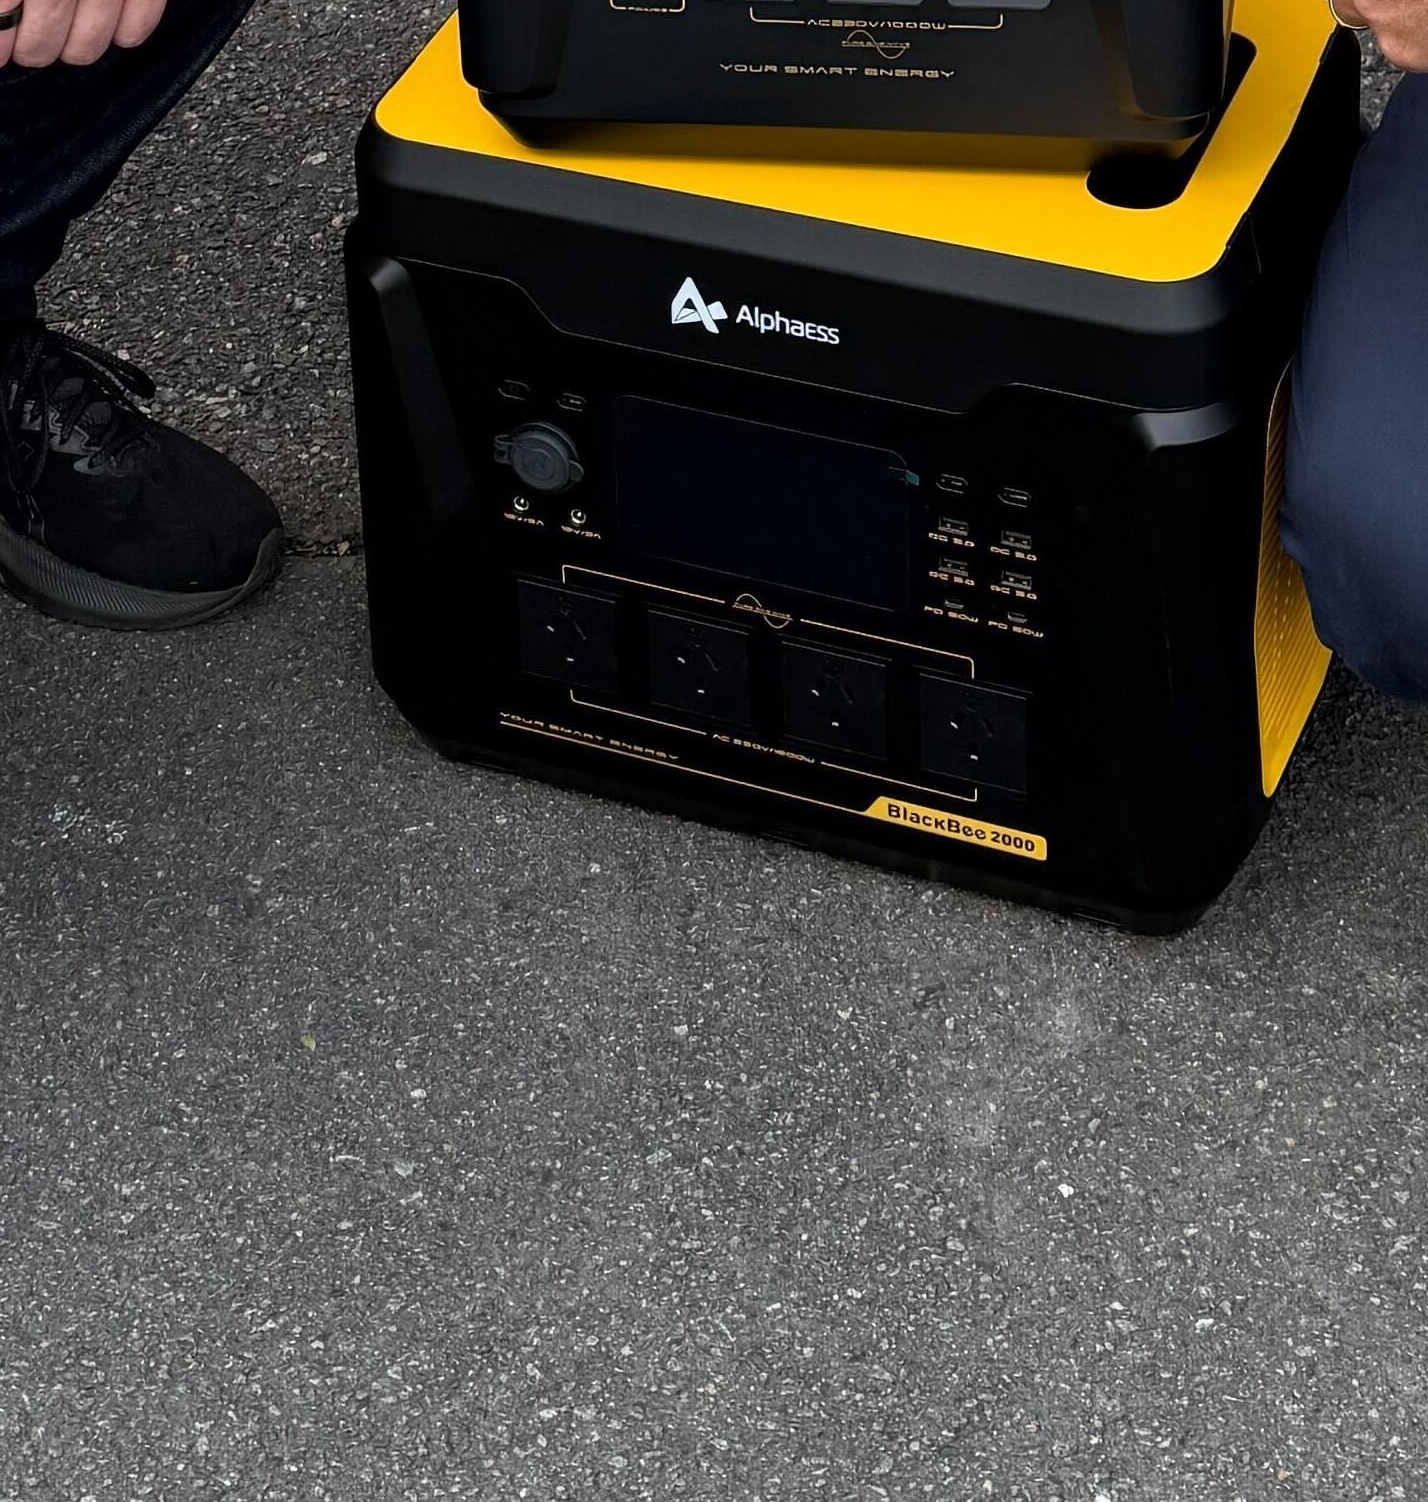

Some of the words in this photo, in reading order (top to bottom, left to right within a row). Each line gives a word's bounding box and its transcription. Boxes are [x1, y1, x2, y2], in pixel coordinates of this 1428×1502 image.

[719, 63, 778, 73] YOUR
[784, 65, 858, 76] SMART
[864, 67, 956, 78] ENERGY
[887, 802, 986, 840] BlackBee
[990, 830, 1035, 852] 2000
